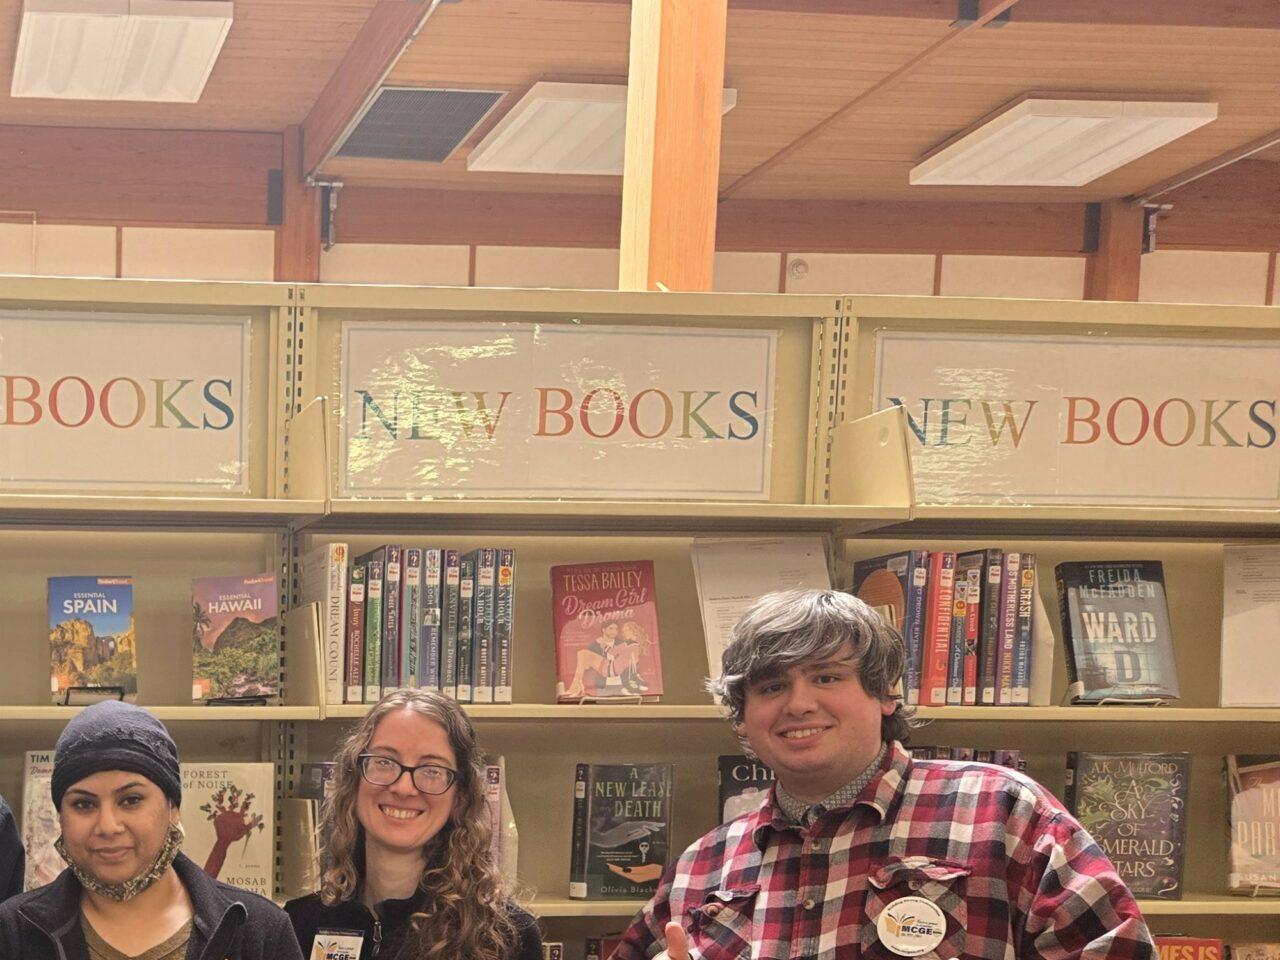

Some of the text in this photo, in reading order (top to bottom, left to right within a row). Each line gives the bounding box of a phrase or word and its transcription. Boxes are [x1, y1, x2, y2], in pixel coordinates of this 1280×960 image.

[0, 375, 235, 432] BOOKS
[354, 386, 760, 442] NEW BOOKS
[886, 395, 1278, 449] NEW BOOKS
[563, 570, 643, 591] TESSA BAILEY
[1088, 568, 1141, 583] FREIDA
[562, 587, 648, 616] Dream Girl
[1080, 584, 1157, 599] McFADDEN
[63, 599, 117, 614] SPAIN
[208, 598, 262, 614] HAWAII
[477, 599, 485, 625] HOUR
[497, 599, 505, 625] HOUR
[1019, 588, 1033, 618] CRASH
[330, 596, 340, 638] DREAM
[578, 608, 635, 629] Drama
[935, 589, 953, 653] CONFIDENTIAL
[1001, 577, 1018, 674] MOTHERLESS LAND NIKKI
[1081, 611, 1158, 644] WARD
[328, 640, 339, 683] COUNT
[446, 649, 455, 684] Drowned
[1113, 650, 1142, 684] D
[30, 754, 50, 763] TIM
[183, 770, 229, 779] FOREST
[629, 767, 639, 779] A
[183, 781, 233, 789] of NOISE
[595, 781, 673, 798] NEW LEASE
[614, 800, 662, 817] DEATH
[1105, 799, 1151, 821] SKY
[1117, 822, 1147, 837] OF
[1112, 861, 1156, 878] TARS
[227, 877, 267, 886] MOSAB
[901, 925, 933, 936] MCGE
